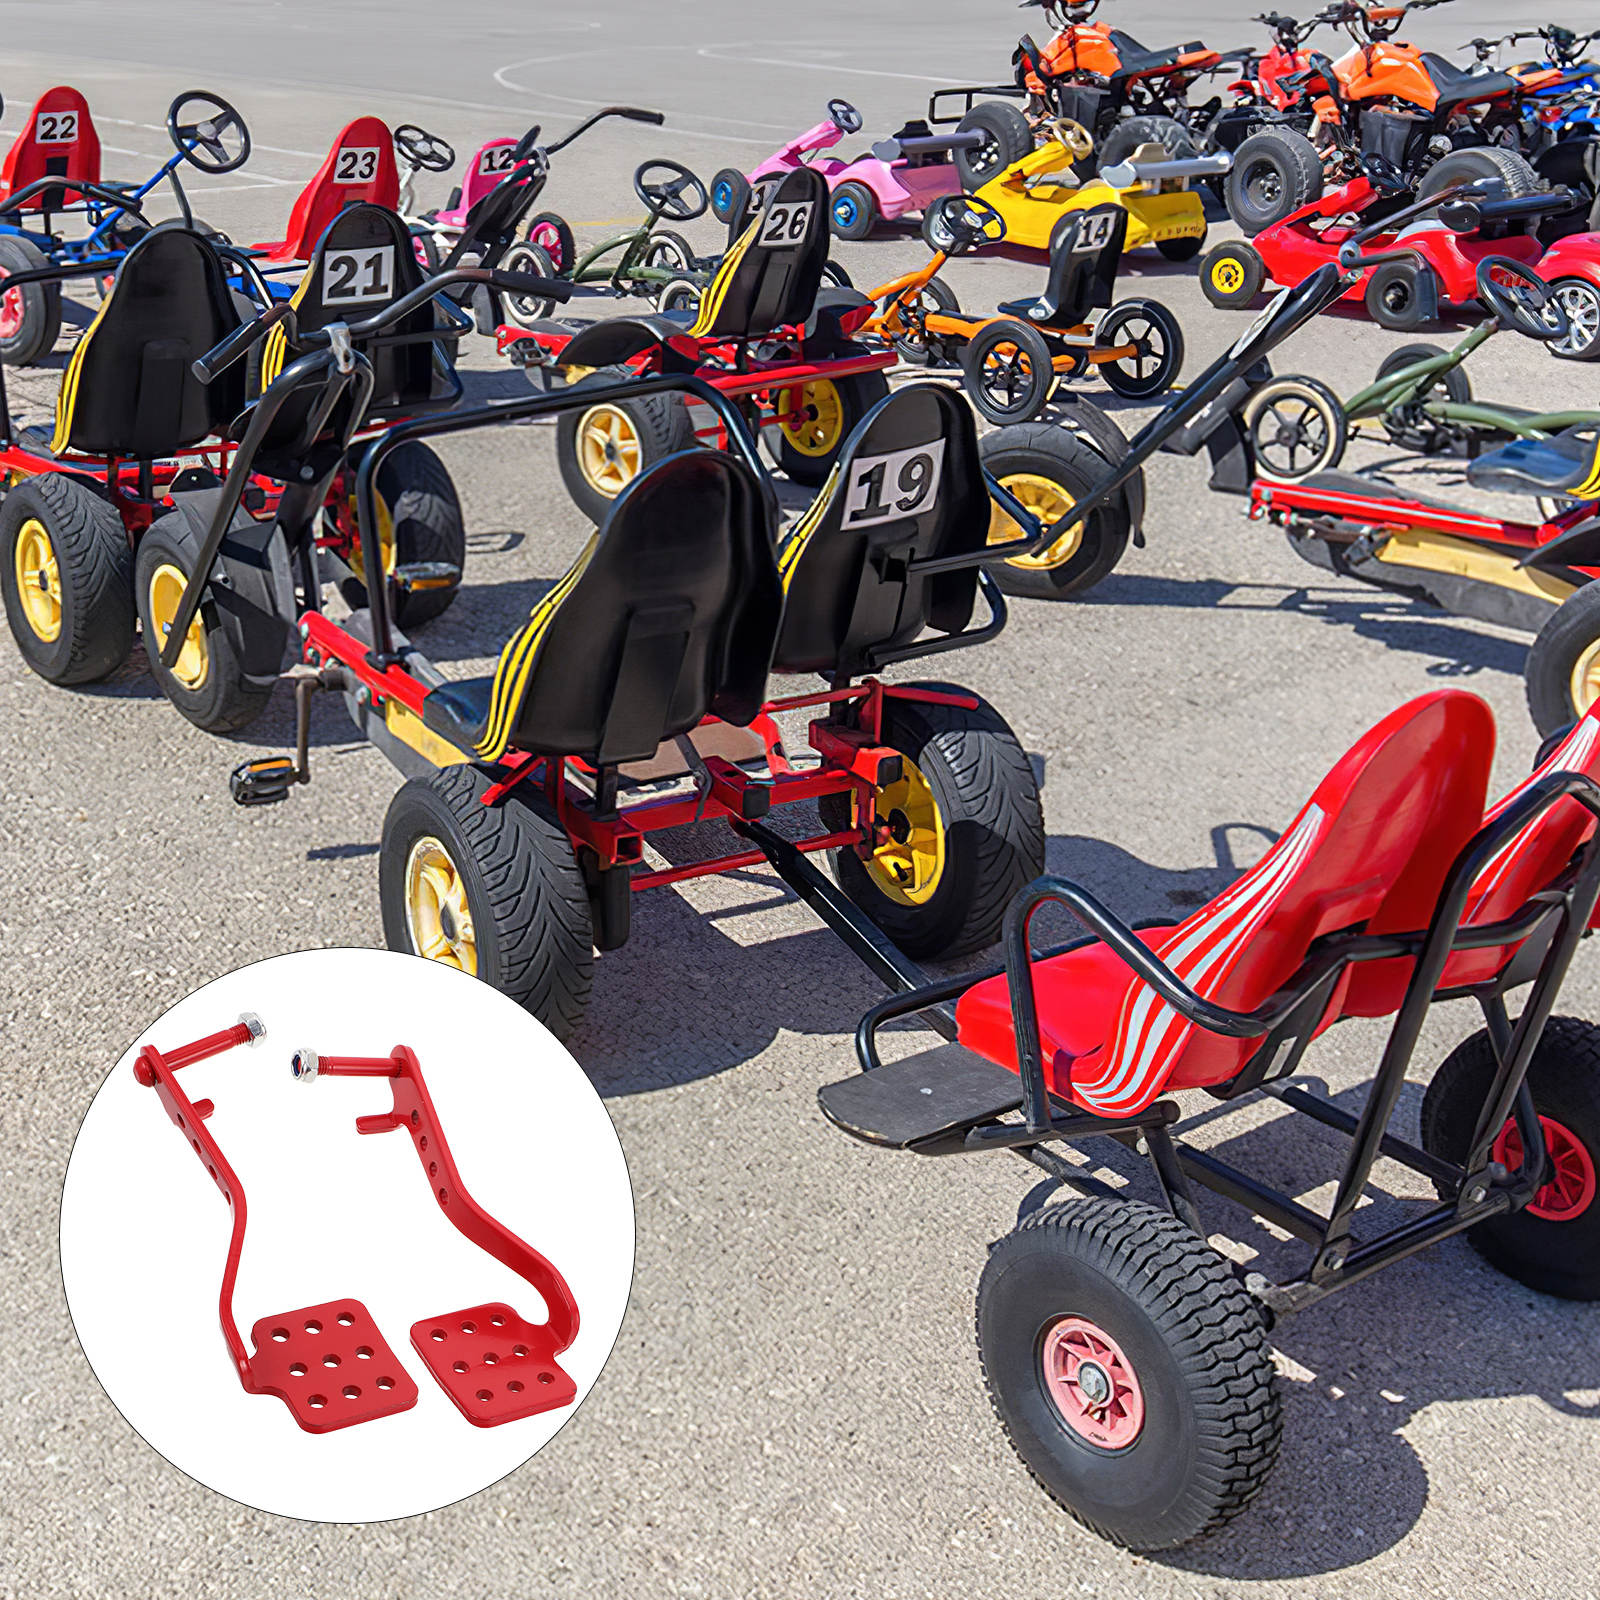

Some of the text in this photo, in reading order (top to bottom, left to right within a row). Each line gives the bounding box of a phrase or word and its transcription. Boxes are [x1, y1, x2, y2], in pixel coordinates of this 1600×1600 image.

[40, 115, 76, 140] 22
[337, 151, 376, 179] 23
[483, 148, 514, 172] 12
[763, 206, 808, 241] 26
[1077, 217, 1109, 248] 14
[327, 252, 389, 299] 21
[848, 453, 934, 522] 19
